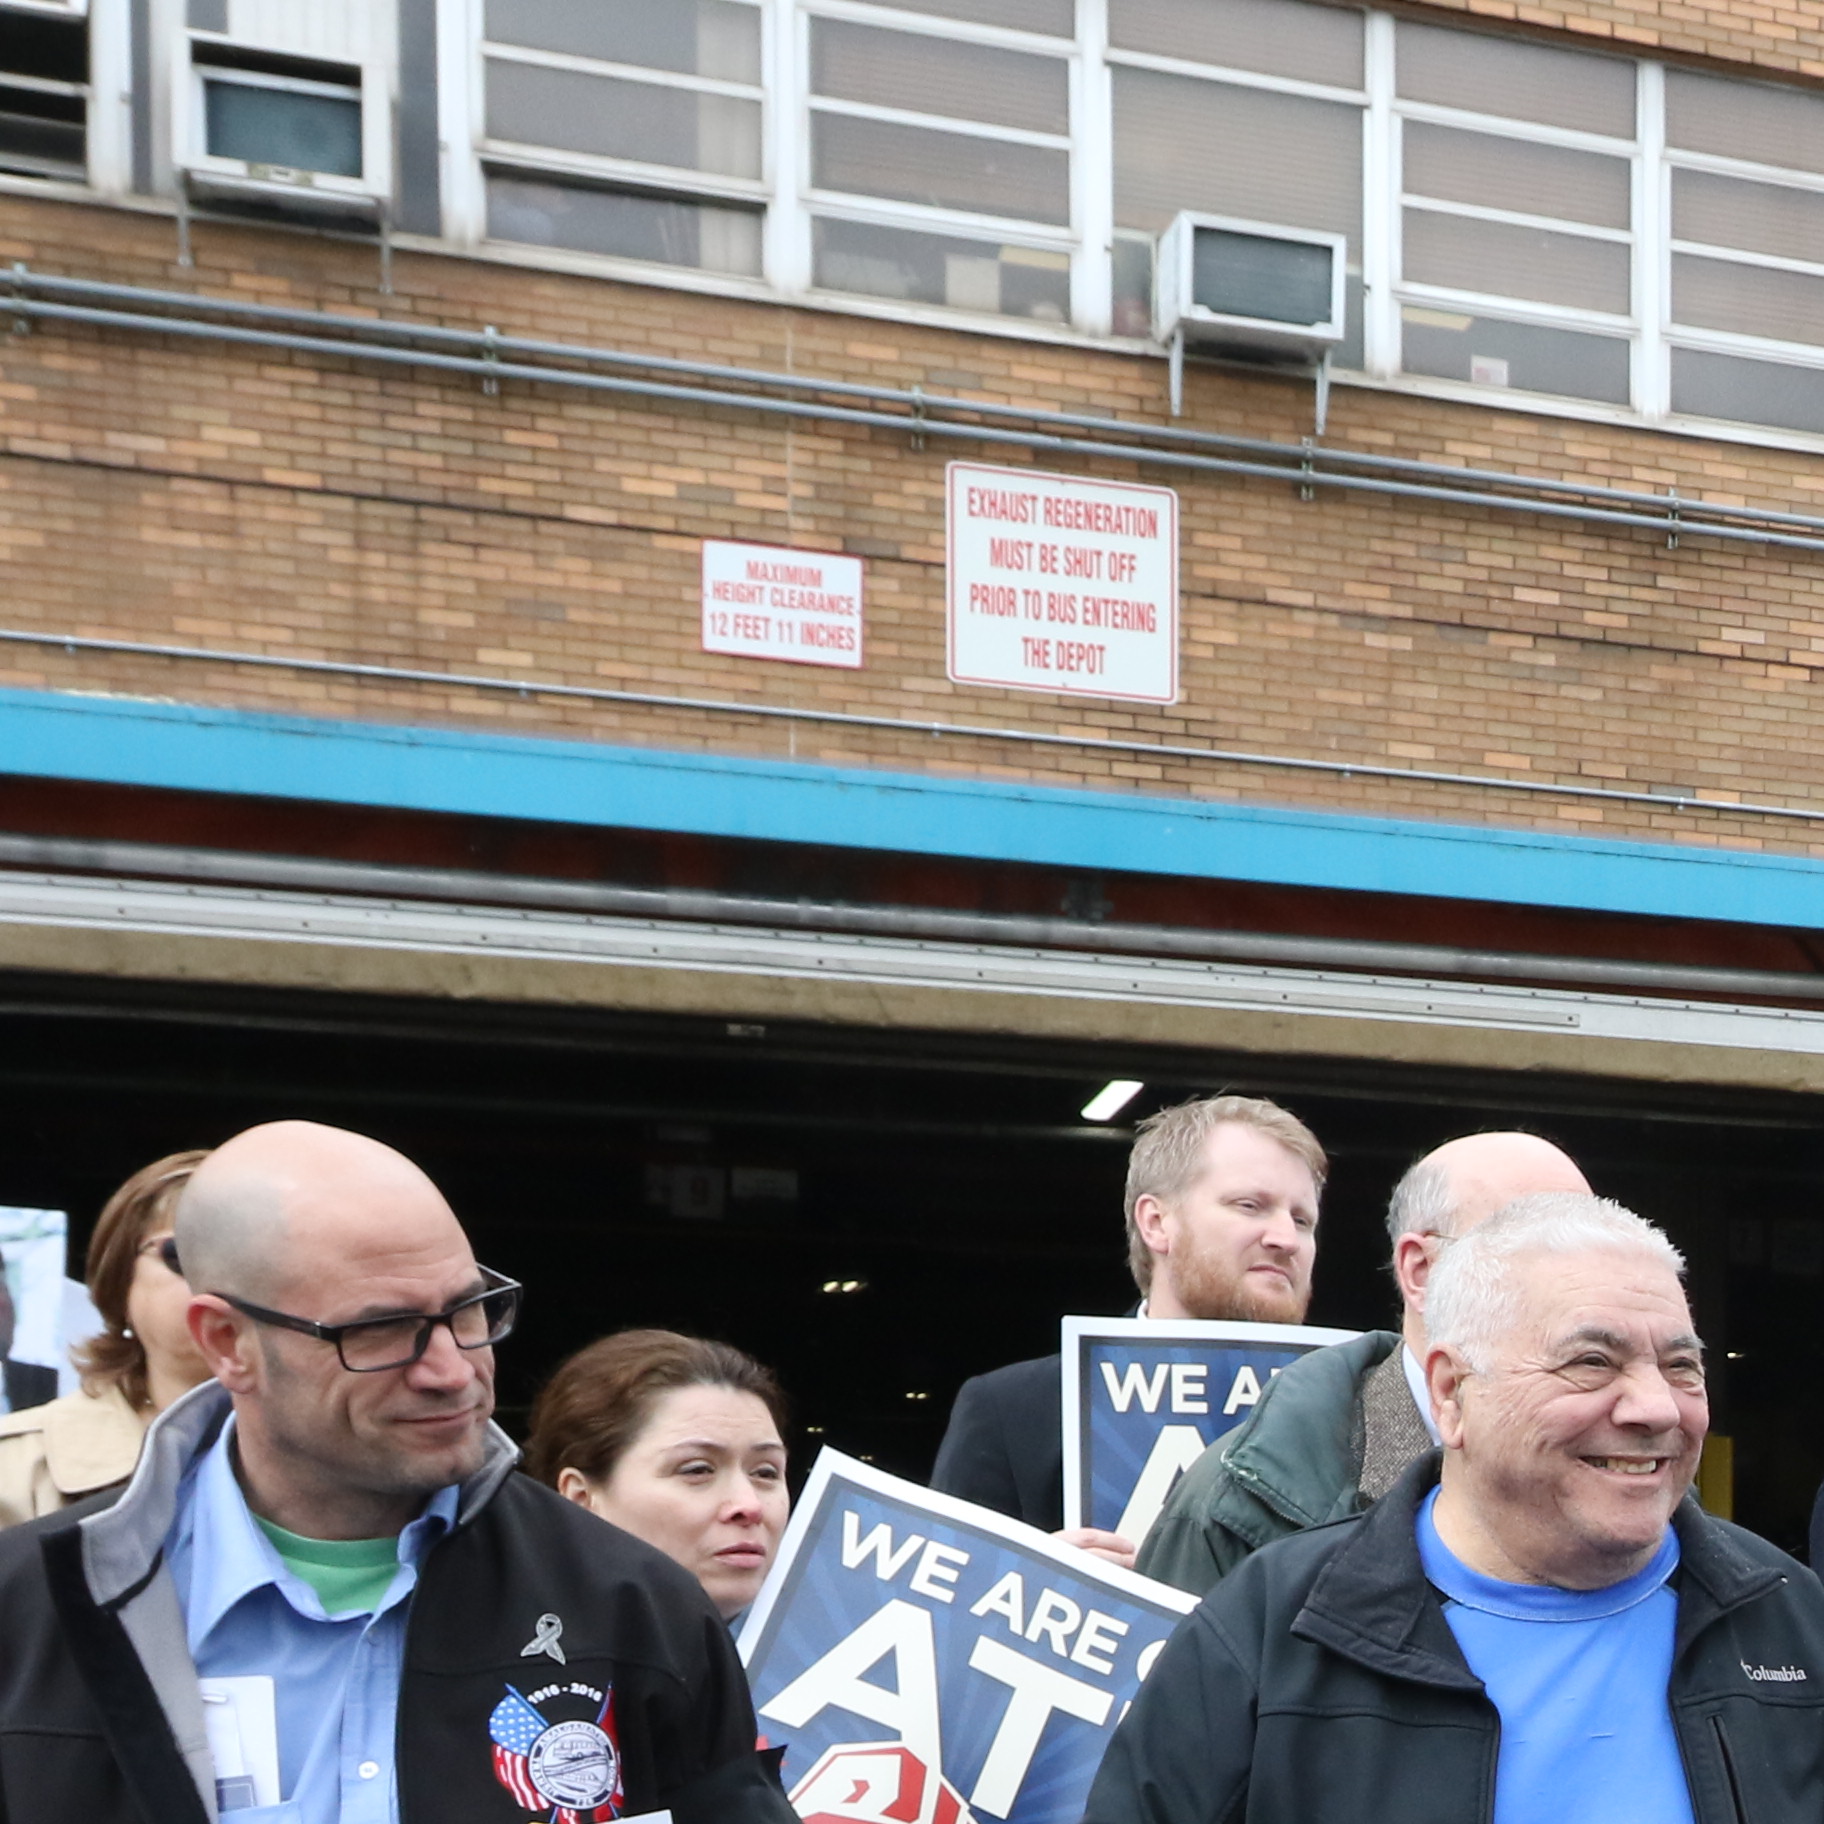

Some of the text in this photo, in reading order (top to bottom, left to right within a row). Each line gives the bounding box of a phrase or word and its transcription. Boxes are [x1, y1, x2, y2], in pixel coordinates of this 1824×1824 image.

[968, 487, 1158, 538] EXHAUST REGENERATION
[746, 561, 822, 586] MAXIMUM
[990, 538, 1136, 583] MUST BE SHUT OFF
[712, 578, 855, 616] HEIGHT CLEARANCE
[970, 583, 1156, 633] PRIOR TO BUS ENTERING
[710, 612, 855, 651] 12 FEET 11 INCHES
[1022, 636, 1105, 674] THE DEPOT
[1100, 1362, 1208, 1414] WE
[840, 1510, 970, 1603] WE
[970, 1573, 1130, 1676] ARE
[1744, 1664, 1807, 1683] Columbia
[758, 1597, 1132, 1820] AT
